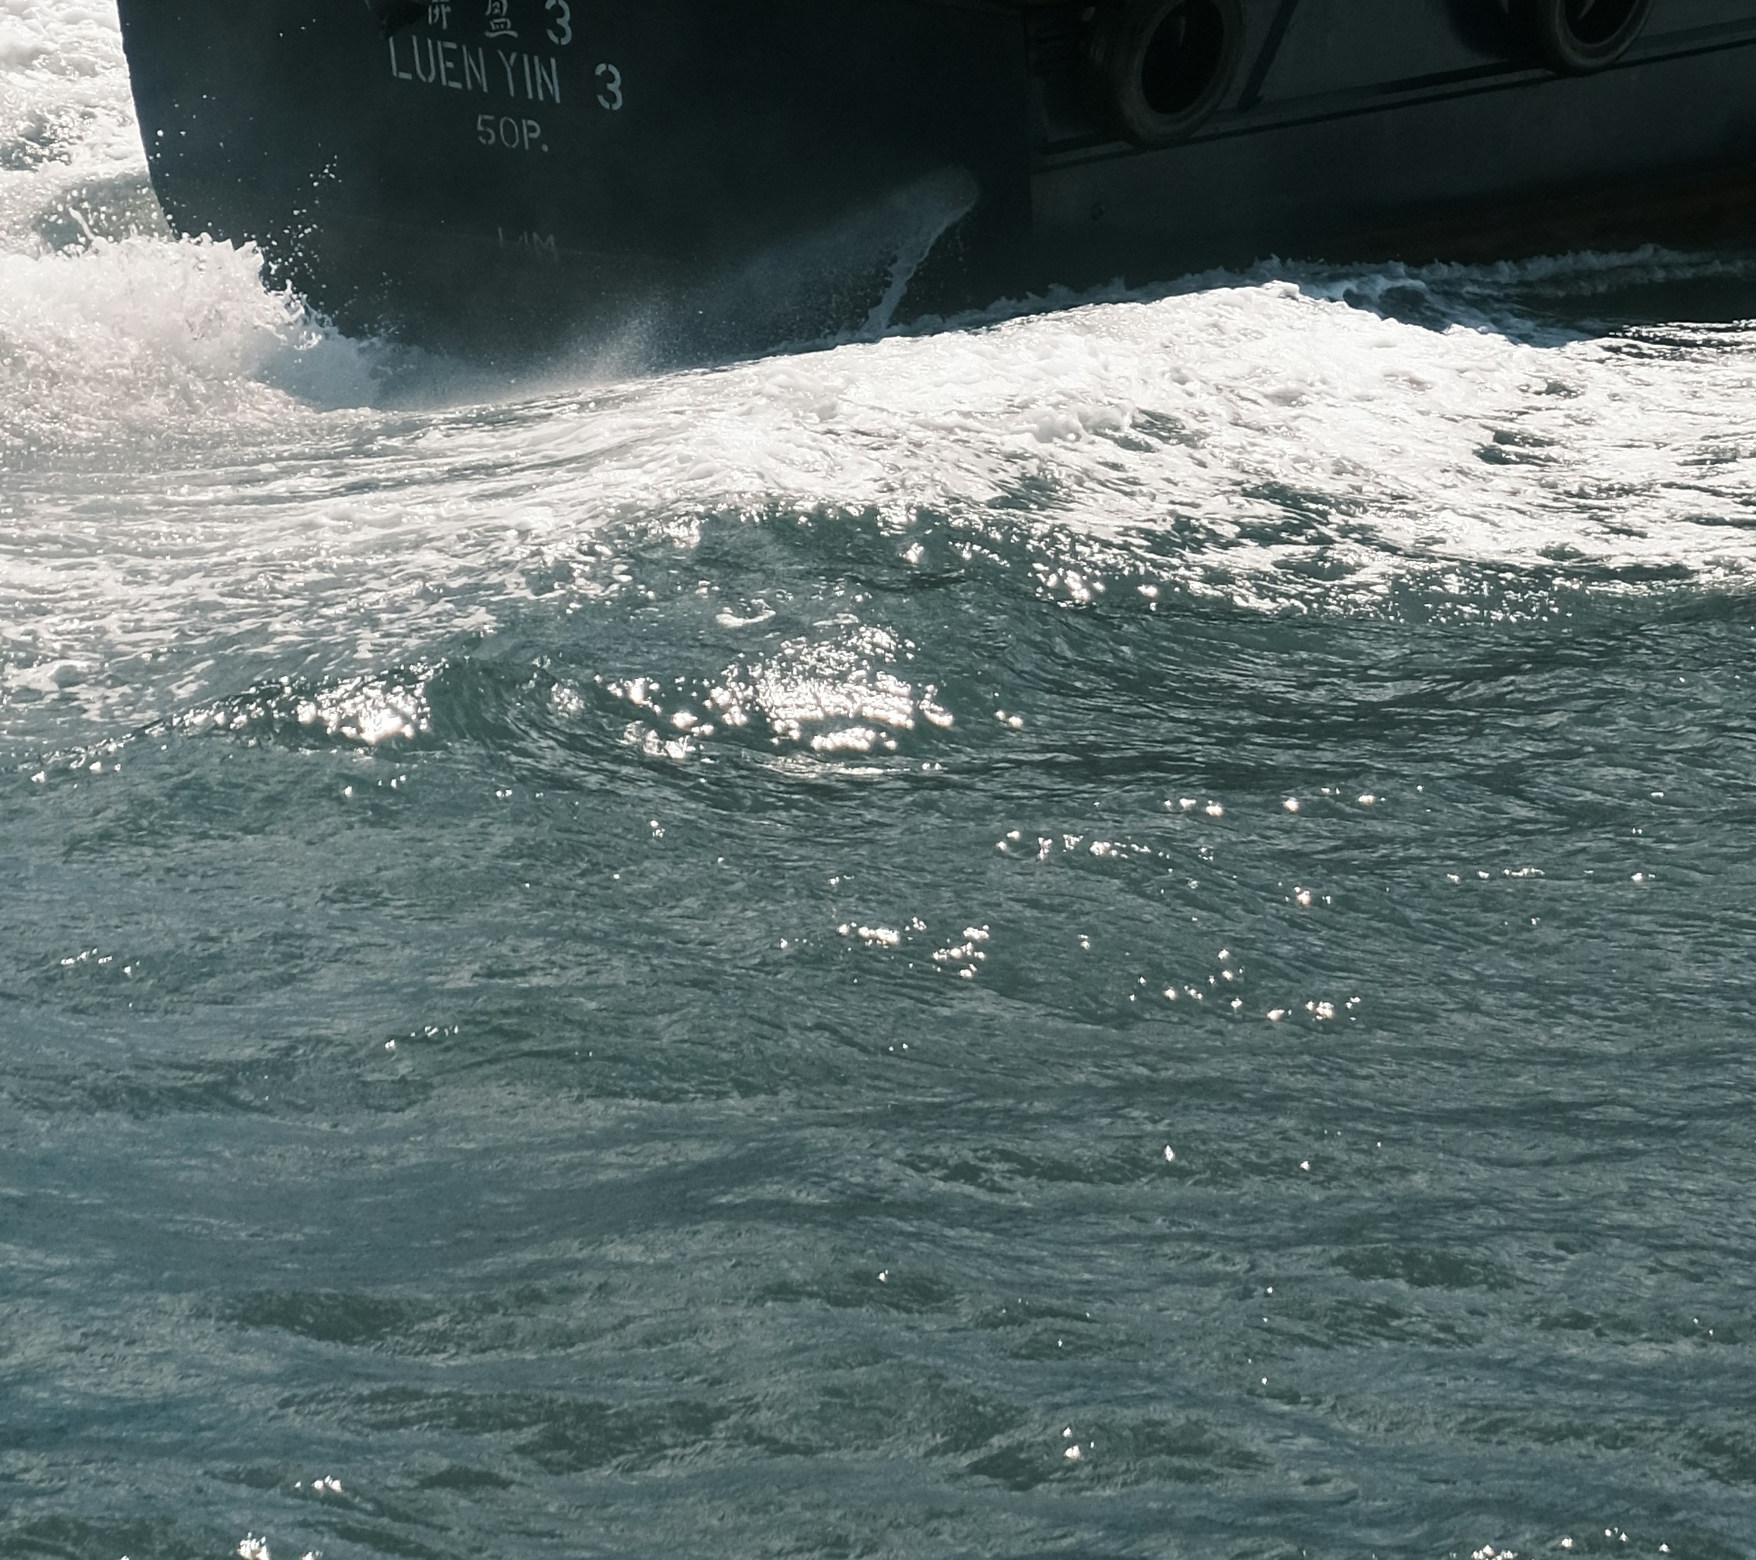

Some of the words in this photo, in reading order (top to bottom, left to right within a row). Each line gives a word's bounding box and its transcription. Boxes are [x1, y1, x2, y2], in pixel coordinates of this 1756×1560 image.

[389, 34, 488, 94] LUEN
[497, 49, 561, 104] YIN
[594, 63, 623, 110] 3
